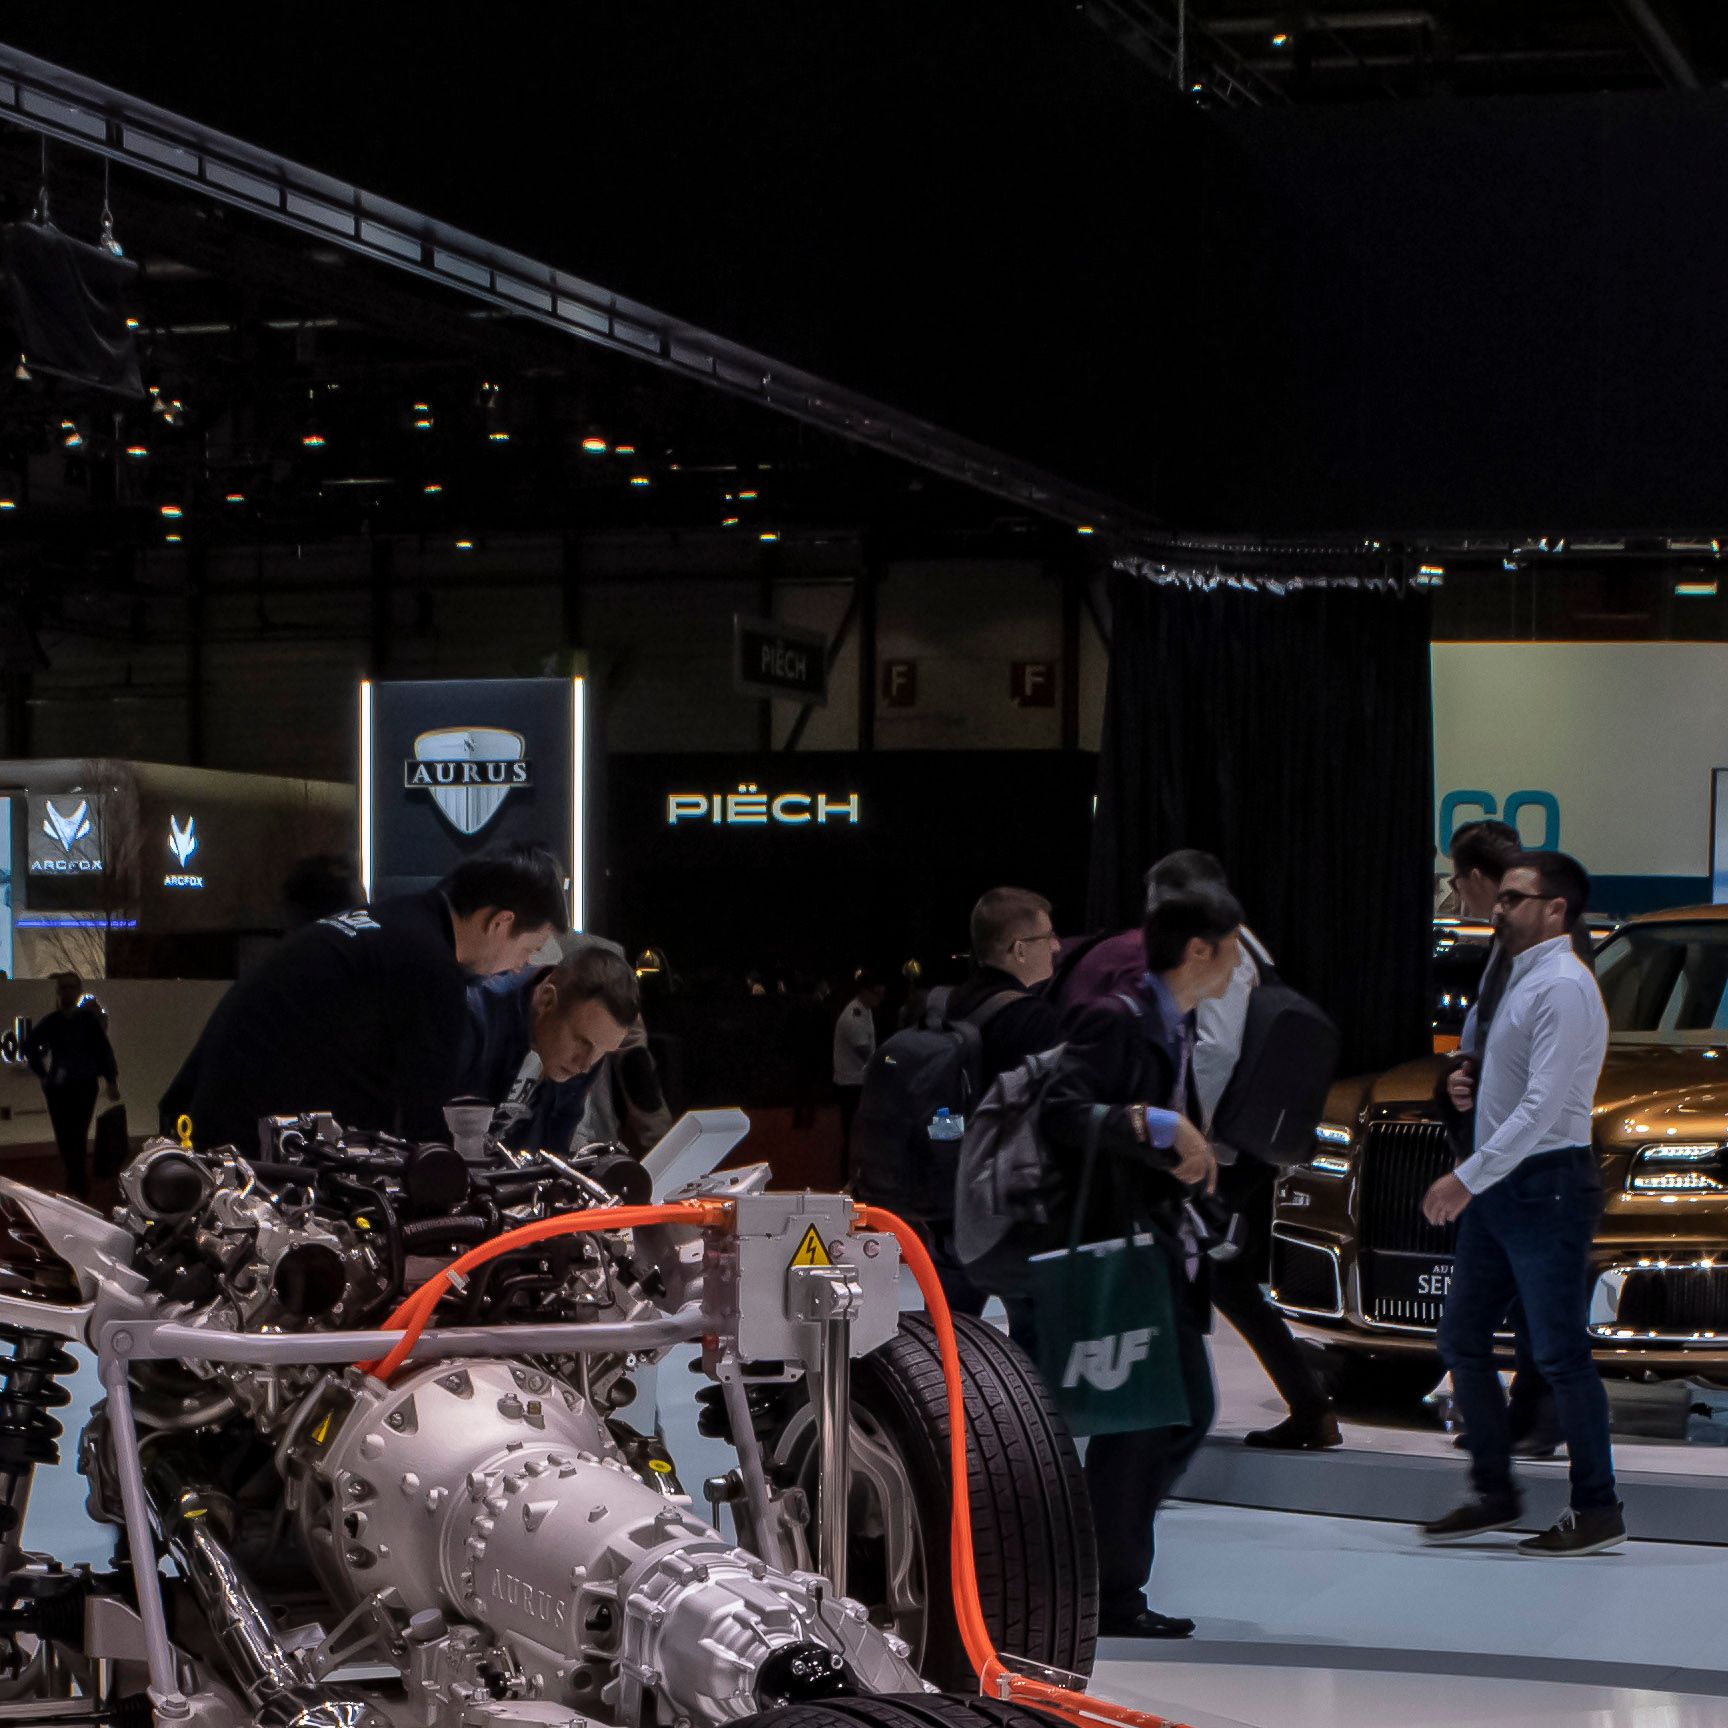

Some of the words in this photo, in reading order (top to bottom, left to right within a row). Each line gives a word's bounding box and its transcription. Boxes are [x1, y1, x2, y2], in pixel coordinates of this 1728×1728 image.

[891, 664, 909, 697] F
[1024, 664, 1045, 697] F
[412, 761, 528, 784] AURUS
[667, 782, 859, 825] PIËCH
[31, 860, 103, 871] ARCFOX
[163, 875, 204, 888] ARCFOX
[491, 1568, 566, 1628] AURUS
